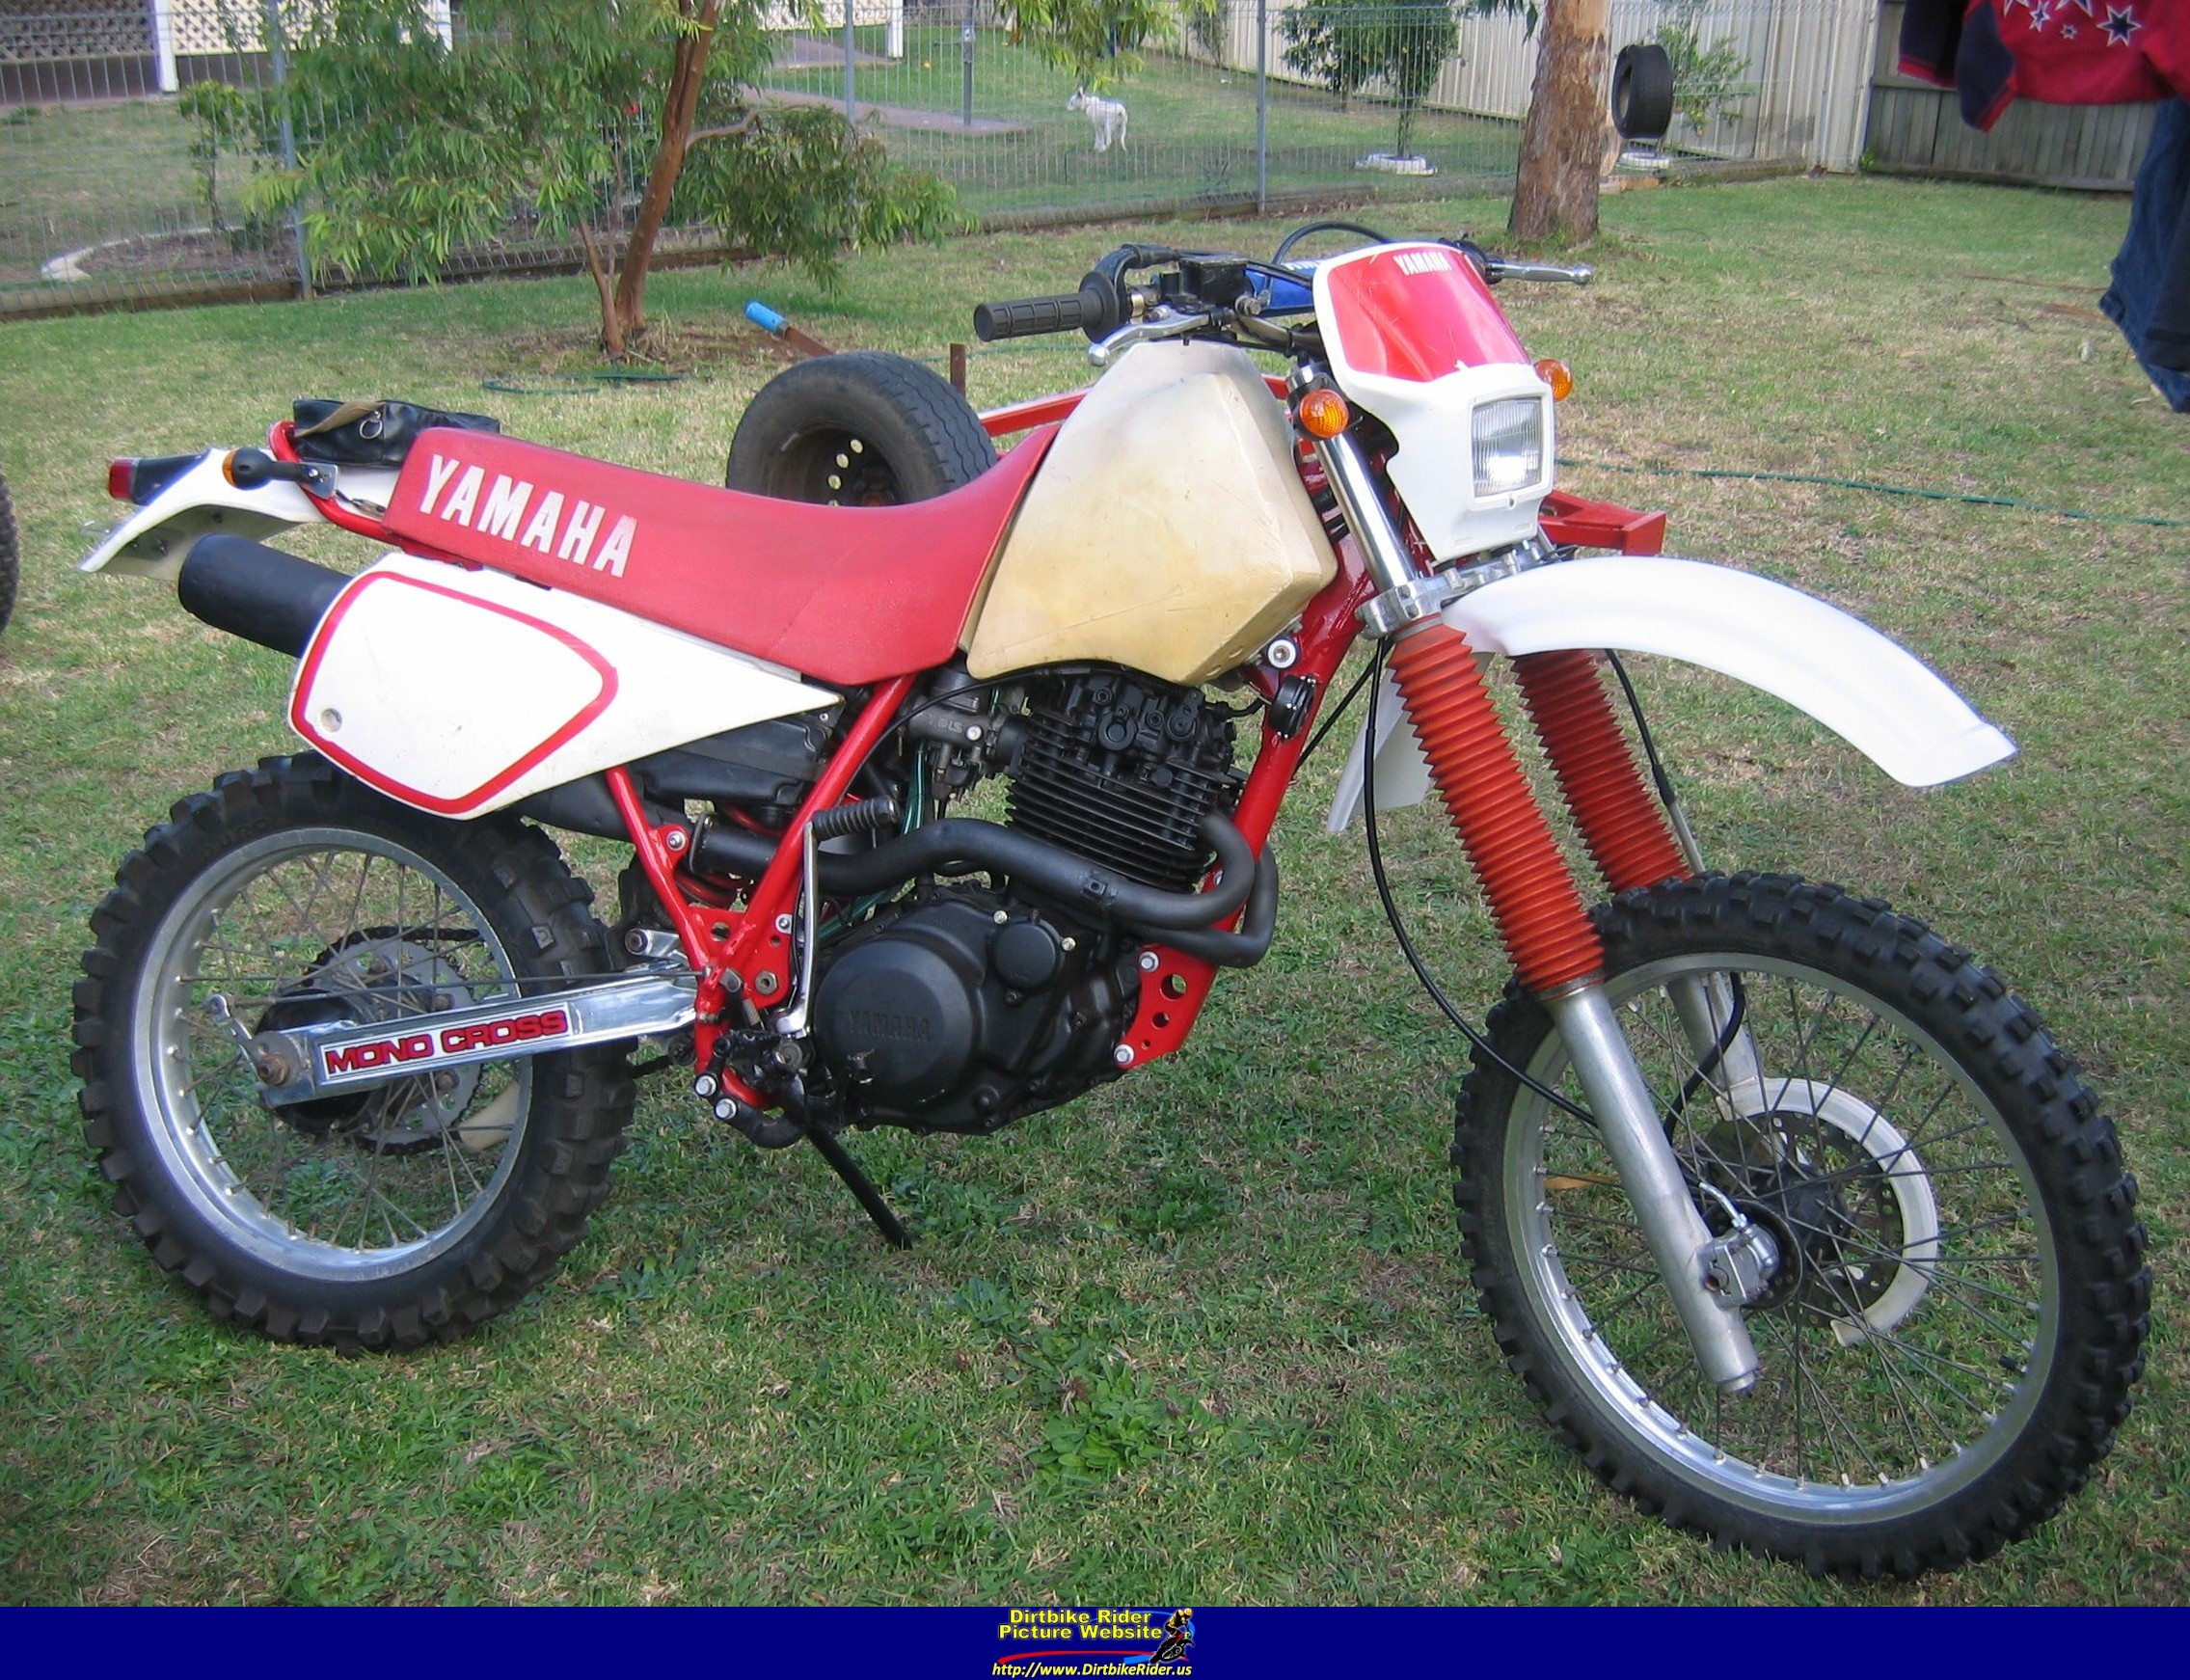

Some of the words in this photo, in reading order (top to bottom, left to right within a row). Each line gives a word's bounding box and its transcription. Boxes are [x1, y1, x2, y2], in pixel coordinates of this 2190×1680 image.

[1392, 251, 1453, 276] YAMAHA
[419, 453, 638, 579] YAMAHA
[325, 1033, 433, 1074] MONO
[440, 1010, 568, 1054] CROSS
[849, 1010, 932, 1043] YAMAHA
